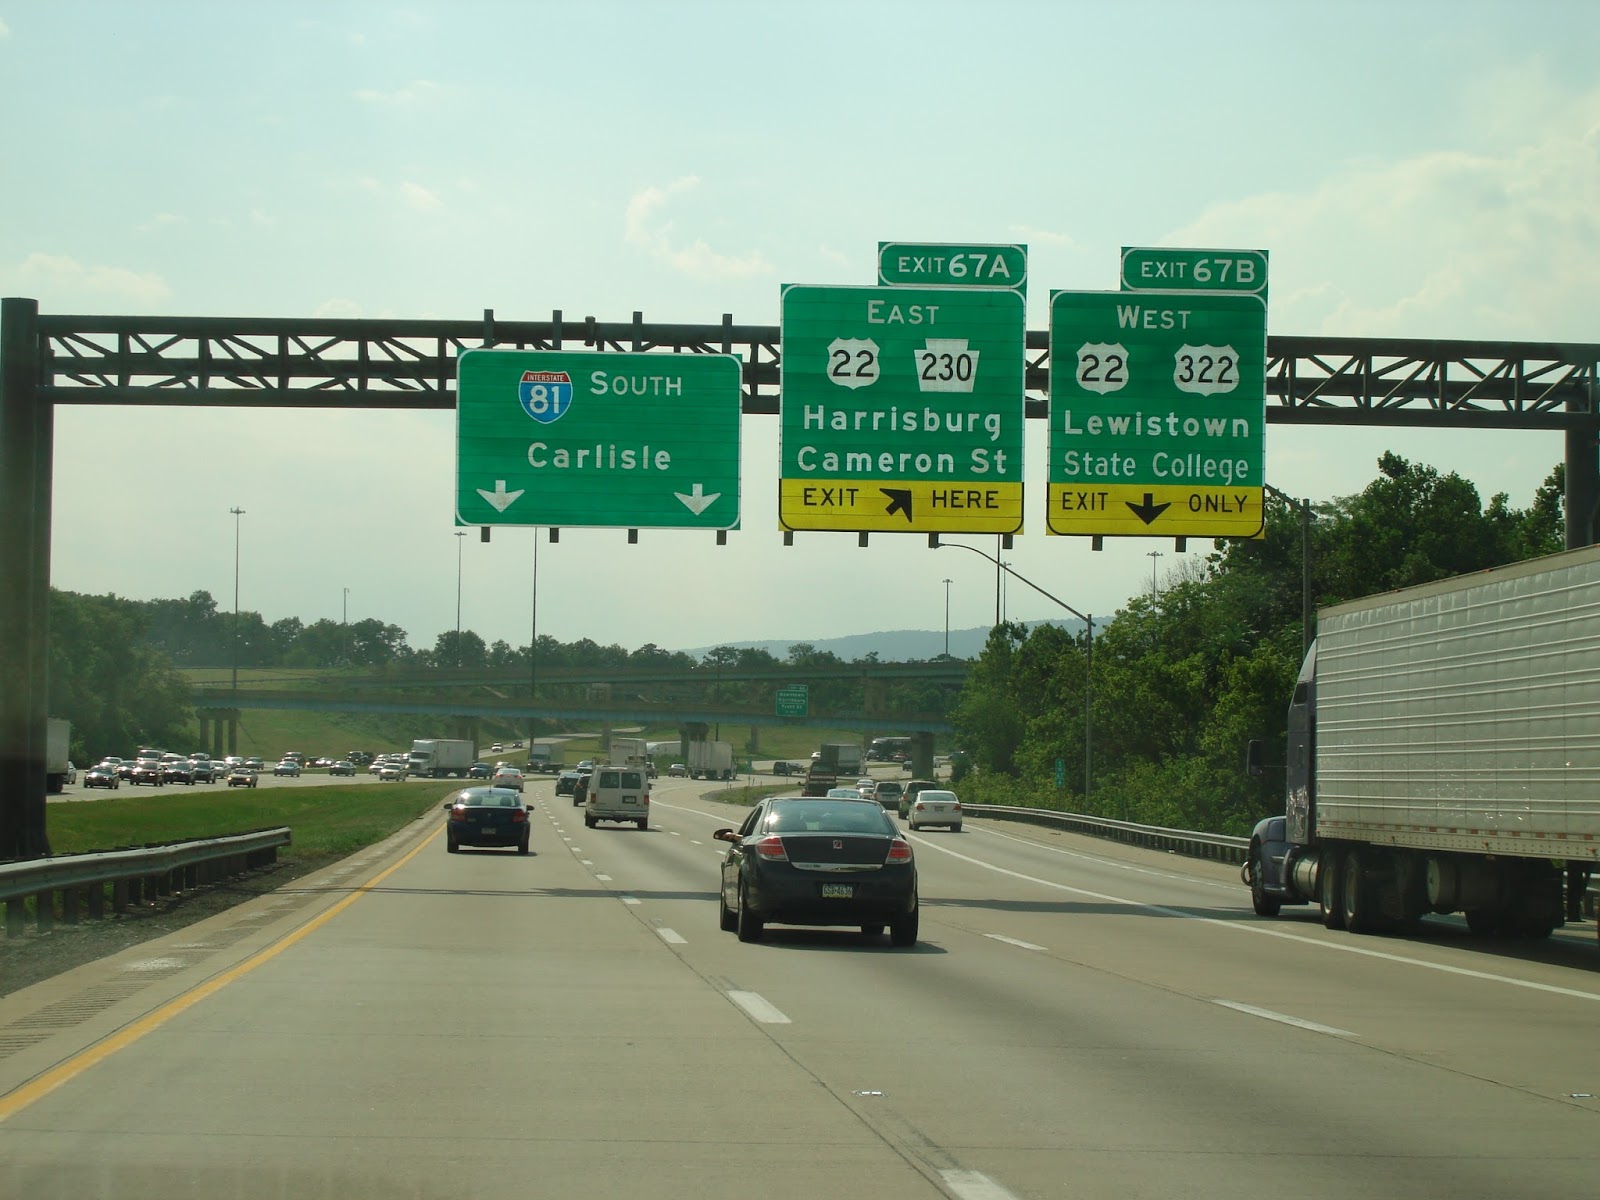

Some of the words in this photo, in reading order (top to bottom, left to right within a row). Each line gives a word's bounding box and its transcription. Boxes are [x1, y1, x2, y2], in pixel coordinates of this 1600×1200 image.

[898, 256, 945, 273] EXIT
[948, 253, 1011, 279] 67A
[1141, 261, 1187, 278] EXIT
[1193, 258, 1256, 283] 67B
[867, 300, 940, 325] EAST
[1116, 304, 1191, 330] WEST
[832, 350, 874, 377] 22
[921, 353, 972, 382] 230
[1081, 354, 1123, 383] 22
[1178, 355, 1233, 384] 322
[527, 374, 565, 382] INTERSTATE
[590, 371, 682, 396] SOUTH
[530, 385, 560, 414] 81
[803, 405, 1001, 442] Harrisburg
[1064, 410, 1249, 438] Lewistown
[527, 442, 671, 470] Carlisle
[797, 446, 954, 473] Cameron
[970, 448, 1007, 475] St
[1064, 450, 1136, 477] State
[1152, 452, 1249, 486] College
[803, 488, 859, 507] EXIT
[932, 490, 999, 509] HERE
[1062, 492, 1108, 511] EXIT
[1188, 494, 1248, 513] ONLY
